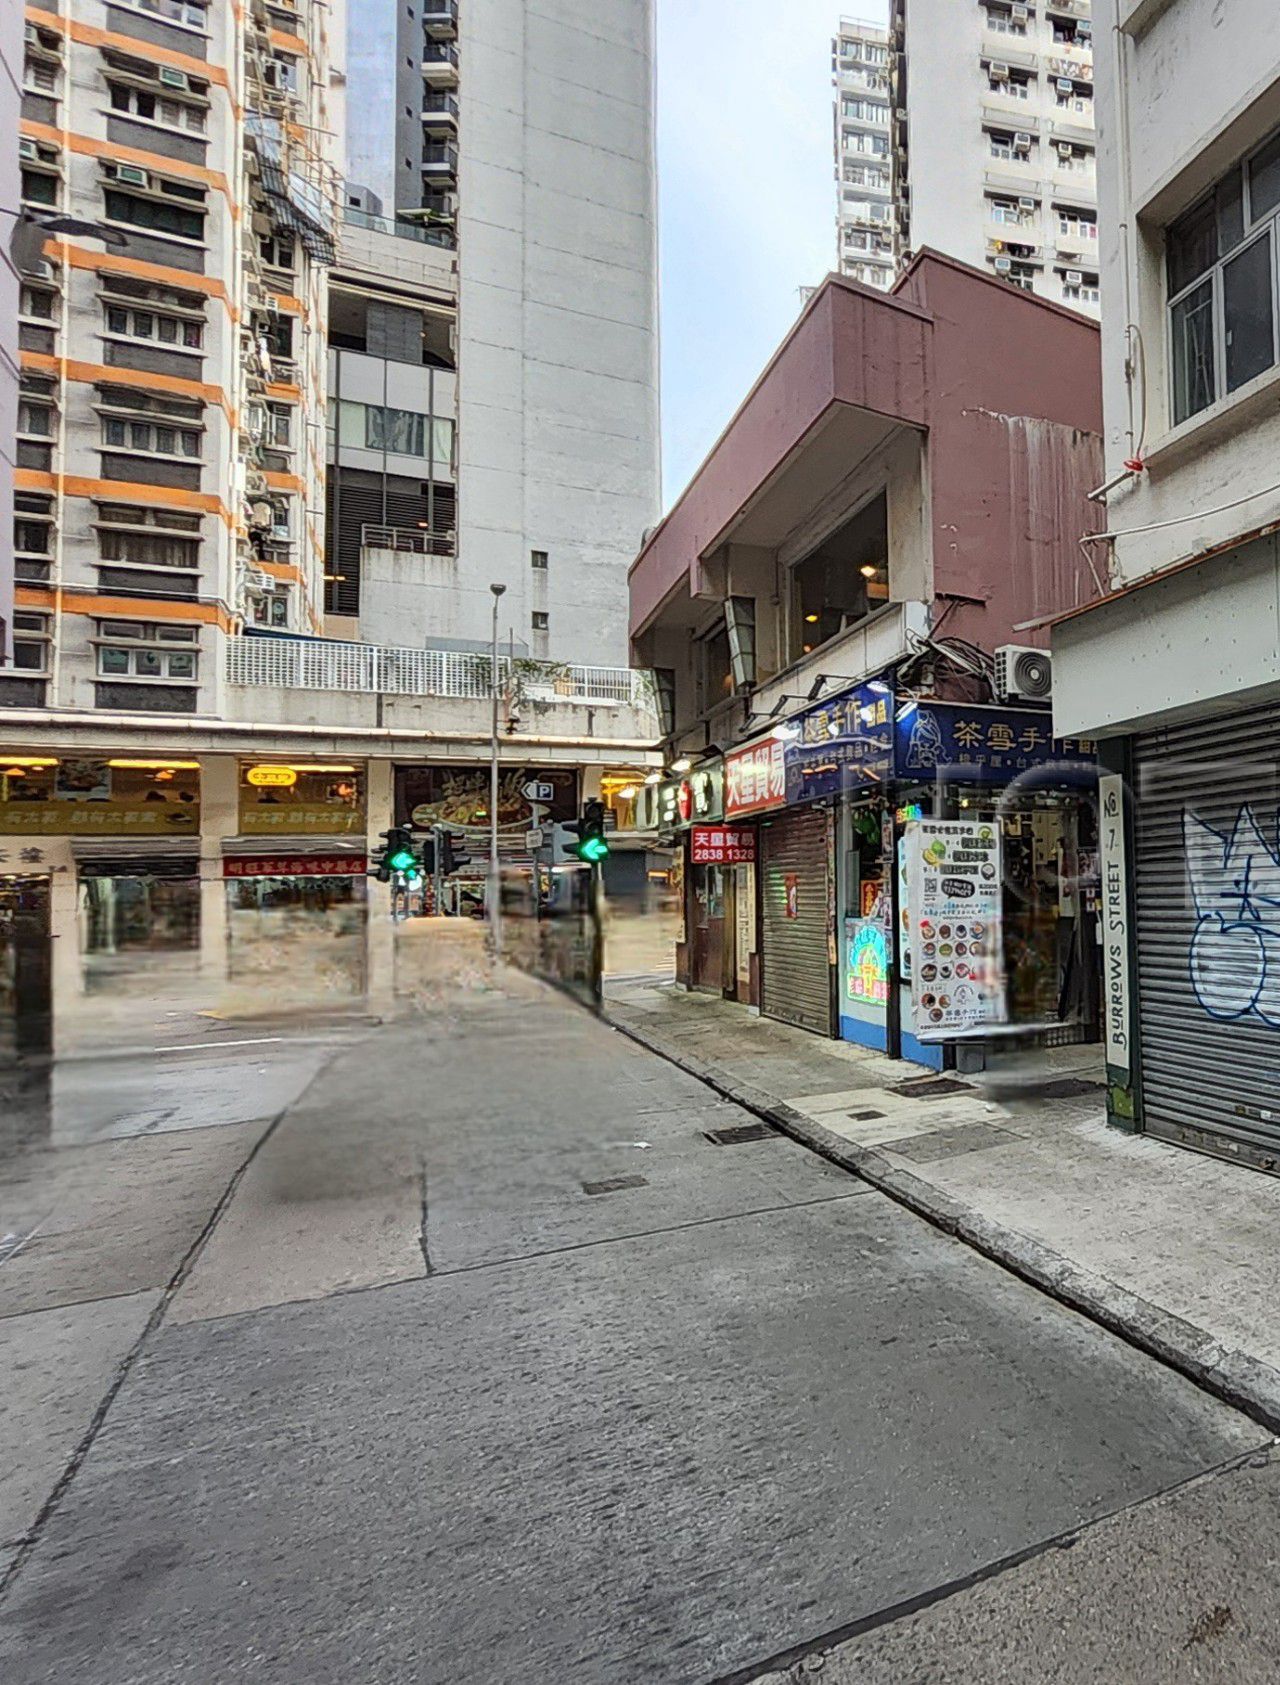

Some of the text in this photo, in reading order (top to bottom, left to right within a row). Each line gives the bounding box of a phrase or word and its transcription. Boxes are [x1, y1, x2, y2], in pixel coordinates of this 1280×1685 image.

[726, 740, 786, 808] 天星貿易
[539, 786, 550, 797] P
[694, 832, 755, 847] 天星貿易
[694, 848, 755, 861] 2838 1328
[1107, 861, 1128, 1050] BURROWS STREET
